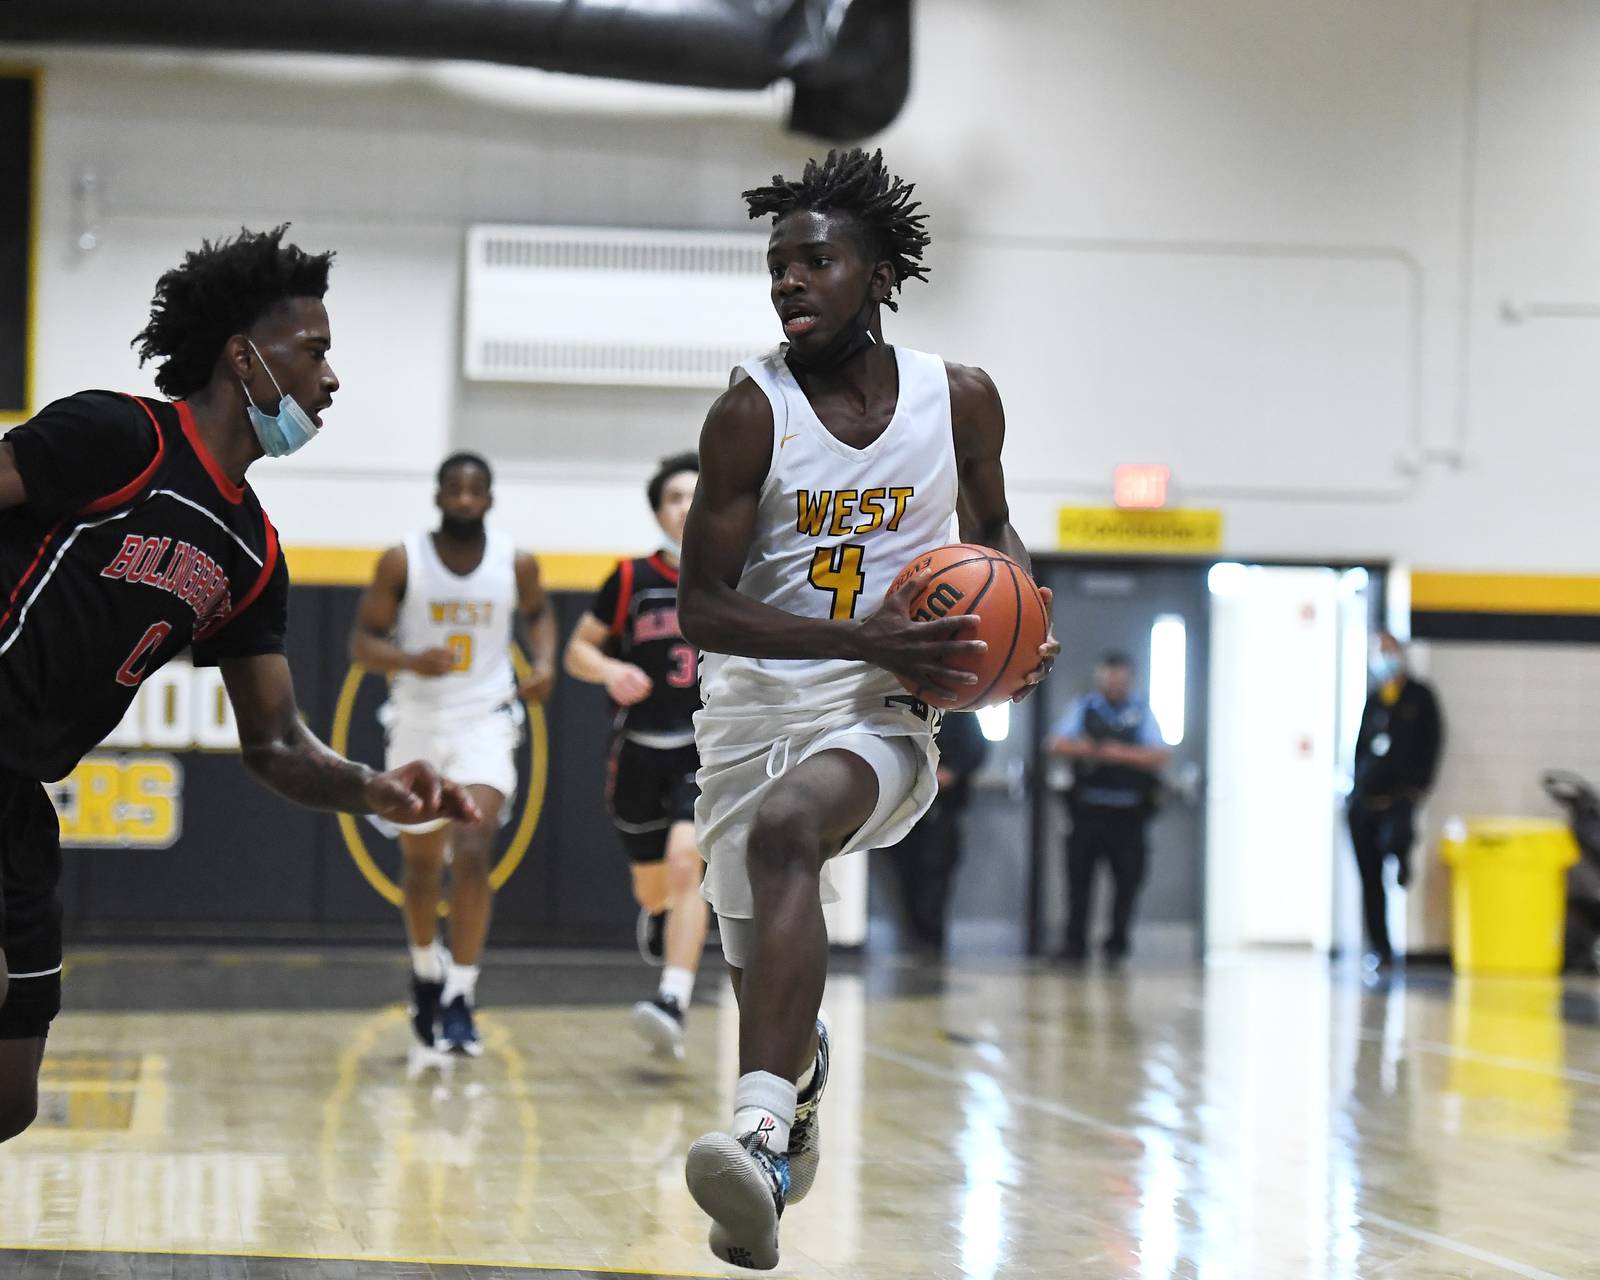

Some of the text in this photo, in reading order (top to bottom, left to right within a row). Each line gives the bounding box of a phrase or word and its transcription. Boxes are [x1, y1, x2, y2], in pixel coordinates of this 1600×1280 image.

[797, 487, 914, 536] WEST
[807, 543, 865, 621] 4
[430, 601, 494, 626] WEST
